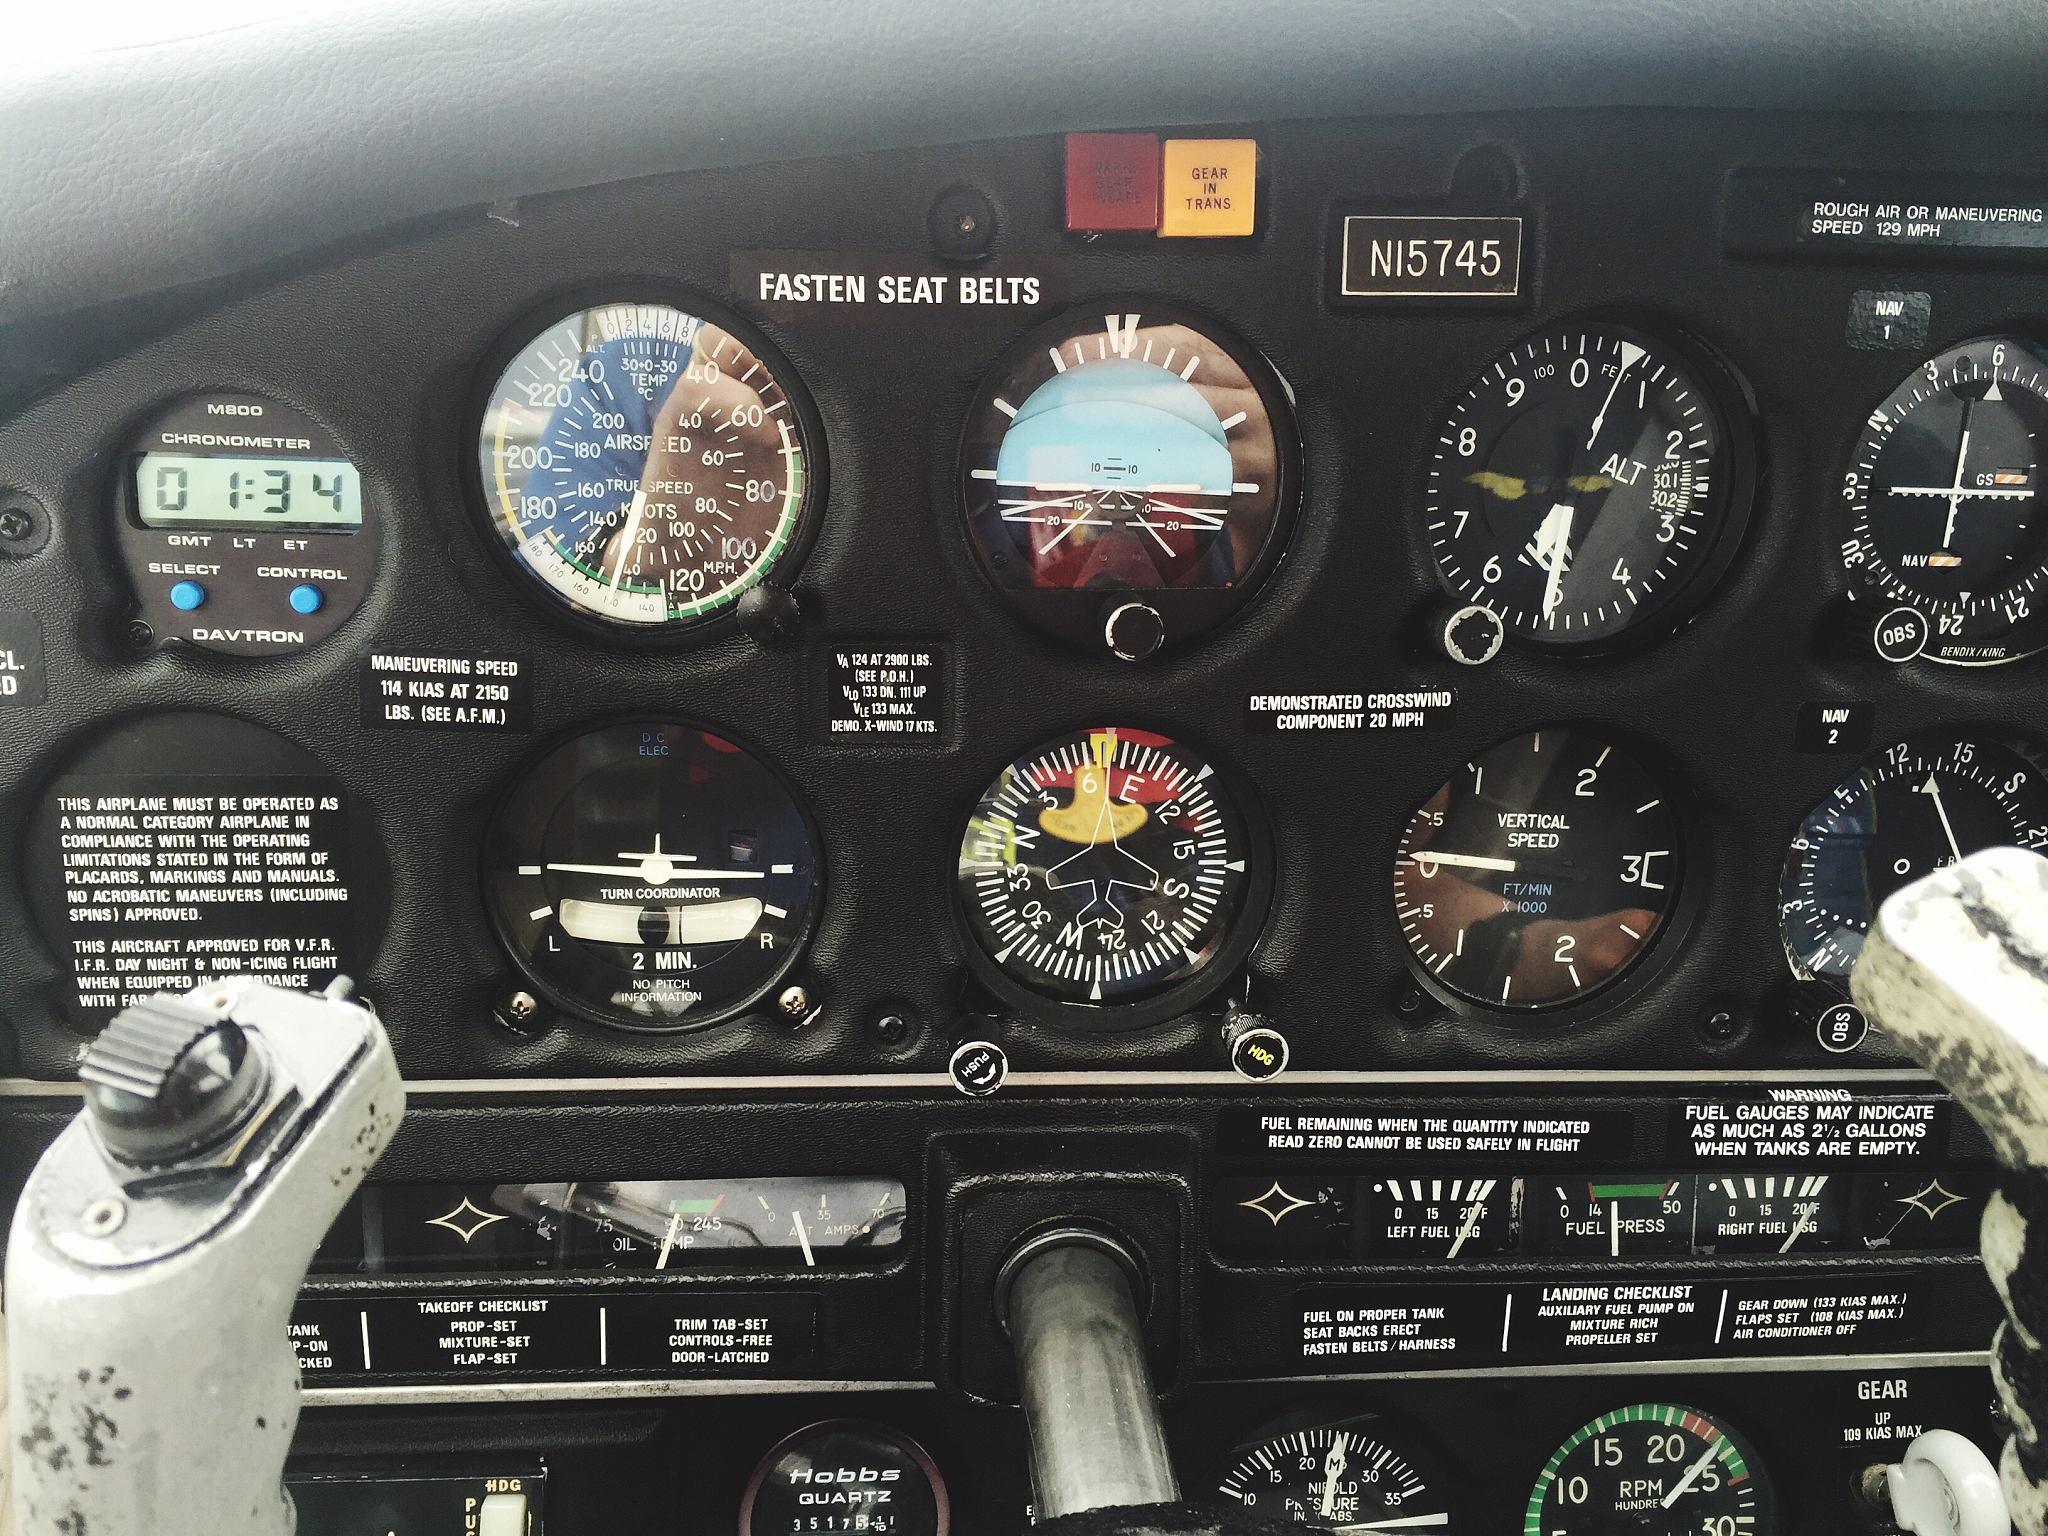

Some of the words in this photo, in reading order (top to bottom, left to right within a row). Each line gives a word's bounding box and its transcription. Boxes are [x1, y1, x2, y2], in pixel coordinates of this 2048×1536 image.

[1192, 168, 1228, 180] GEAR
[1204, 184, 1216, 195] IN
[1186, 198, 1231, 210] TRANS
[1814, 203, 1869, 217] ROUGH
[1876, 205, 1900, 218] AIR
[1907, 205, 1929, 220] OR
[1935, 207, 2042, 223] MANEUVERING
[1812, 219, 1862, 234] SPEED
[1876, 222, 1901, 235] 129
[1907, 223, 1941, 237] MPH
[760, 273, 865, 302] FASTEN
[878, 277, 947, 304] SEAT
[960, 277, 1040, 304] BELTS
[1876, 301, 1904, 316] NAV
[1883, 325, 1891, 339] 1
[559, 359, 604, 382] 240
[630, 375, 668, 386] TEMP
[529, 384, 572, 406] 220
[207, 403, 263, 416] M800
[161, 433, 311, 450] CHRONOMETER
[507, 447, 552, 469] 200
[1600, 453, 1647, 485] ALT
[1976, 474, 1993, 486] GS
[521, 497, 556, 518] 180
[168, 536, 211, 547] GMT
[233, 538, 255, 549] LT
[284, 540, 308, 550] ET
[1902, 555, 1928, 567] NAV
[148, 563, 220, 575] SELECT
[257, 567, 347, 580] CONTROL
[670, 570, 704, 591] 120
[192, 628, 304, 644] DAVTRON
[1883, 623, 1915, 647] OBS
[852, 654, 867, 665] 124
[870, 654, 882, 665] AT
[885, 654, 908, 665] 2900
[912, 654, 932, 665] LBS.
[1941, 647, 2005, 657] BENDIX/KING
[371, 655, 470, 674] MANEUVERING
[476, 661, 518, 676] SPEED
[856, 669, 876, 683] (SEE
[381, 680, 402, 696] 114
[409, 681, 444, 698] KIAS
[450, 684, 469, 699] AT
[475, 685, 509, 700] 2150
[862, 686, 877, 697] 133
[880, 686, 896, 698] DN.
[900, 686, 911, 698] 111
[913, 686, 926, 698] UP
[872, 703, 887, 714] 133
[890, 704, 916, 714] MAX.
[1250, 695, 1362, 710] DEMONSTRATED
[1368, 692, 1451, 708] CROSSWIND
[385, 705, 414, 720] LBS.
[422, 706, 451, 722] (SEE
[456, 708, 506, 725] A.F.M.)
[1277, 714, 1364, 730] COMPONENT
[1370, 713, 1387, 728] 20
[1392, 712, 1424, 727] MPH
[1822, 709, 1849, 723] NAV
[832, 720, 862, 732] DEMO.
[864, 720, 903, 732] X-WIND
[905, 721, 914, 732] 17
[916, 721, 937, 732] KTS.
[1828, 729, 1838, 744] 2
[58, 798, 90, 811] THIS
[97, 798, 167, 811] AIRPLANE
[173, 798, 213, 811] MUST
[219, 798, 237, 811] BE
[243, 797, 314, 811] OPERATED
[320, 797, 338, 810] AS
[1498, 813, 1570, 830] VERTICAL
[1508, 834, 1559, 848] SPEED
[67, 889, 87, 903] NO
[93, 889, 170, 903] ACROBATIC
[176, 889, 263, 902] MANEUVERS
[270, 888, 348, 902] (INCLUDING
[601, 888, 633, 899] TURN
[636, 887, 720, 899] COORDINATOR
[1503, 884, 1552, 896] FT/MIN
[632, 953, 644, 969] 2
[656, 952, 697, 969] MIN.
[633, 980, 650, 989] NO
[656, 979, 690, 989] PITCH
[621, 992, 702, 1002] INFORMATION
[1832, 1012, 1850, 1041] OBS
[1247, 1045, 1275, 1067] HDG
[961, 1051, 990, 1078] PUSH
[1768, 1089, 1852, 1102] WARNING
[1686, 1106, 1730, 1120] FUEL
[1736, 1106, 1808, 1120] GAUGES
[1816, 1106, 1852, 1120] MAY
[1859, 1105, 1935, 1120] INDICATE
[1261, 1116, 1292, 1130] FUEL
[1298, 1117, 1372, 1132] REMAINING
[1378, 1118, 1418, 1132] WHEN
[1423, 1118, 1448, 1132] THE
[1452, 1119, 1518, 1133] QUANTITY
[1523, 1120, 1590, 1135] INDICATED
[1268, 1135, 1303, 1149] READ
[1308, 1135, 1342, 1149] ZERO
[1347, 1136, 1401, 1150] CANNOT
[1406, 1137, 1422, 1150] BE
[1427, 1137, 1461, 1150] USED
[1466, 1137, 1512, 1151] SAFELY
[1517, 1138, 1531, 1151] IN
[1536, 1138, 1580, 1152] FLIGHT
[1387, 1226, 1416, 1238] LEFT
[1421, 1226, 1450, 1238] FUEL
[1718, 1223, 1754, 1236] RIGHT
[1759, 1222, 1788, 1234] FUEL
[613, 1238, 636, 1251] OIL
[1543, 1288, 1609, 1301] LANDING
[1614, 1286, 1693, 1300] CHECKLIST
[418, 1301, 473, 1314] TAKEOFF
[478, 1300, 548, 1313] CHECKLIST
[1739, 1300, 1768, 1311] GEAR
[1773, 1298, 1808, 1310] DOWN
[1813, 1297, 1836, 1309] (133
[1840, 1296, 1867, 1307] KIAS
[1871, 1293, 1907, 1305] MAX.)
[1304, 1311, 1332, 1323] FUEL
[1337, 1311, 1354, 1322] ON
[1359, 1308, 1407, 1321] PROPER
[1412, 1308, 1445, 1319] TANK
[450, 1319, 517, 1334] PROP-SET
[674, 1318, 707, 1331] TRIM
[713, 1317, 768, 1331] TAB-SET
[1570, 1319, 1625, 1330] MIXTURE
[1630, 1318, 1658, 1329] RICH
[439, 1336, 530, 1350] MIXTURE-SET
[669, 1334, 773, 1348] CONTROLS-FREE
[453, 1352, 517, 1366] FLAP-SET
[671, 1350, 770, 1364] DOOR-LATCHED
[1858, 1379, 1908, 1400] GEAR
[1875, 1412, 1891, 1425] UP
[1843, 1428, 1863, 1442] 109
[1865, 1427, 1892, 1440] KIAS
[1896, 1426, 1923, 1439] MAX
[790, 1469, 900, 1484] Hobbs
[485, 1479, 521, 1492] HDG
[1619, 1479, 1663, 1498] RPM
[799, 1491, 892, 1505] QUARTZ
